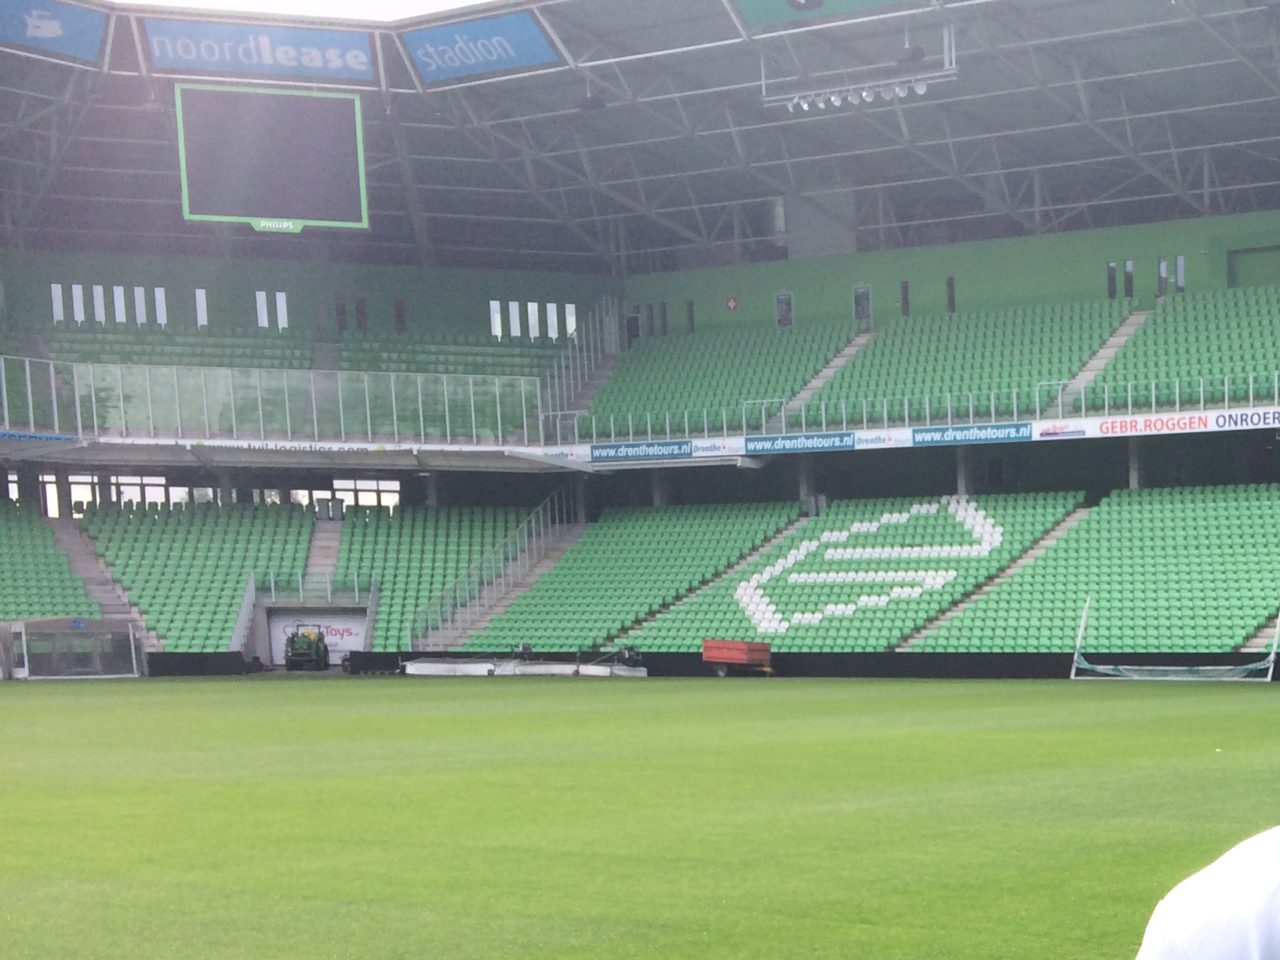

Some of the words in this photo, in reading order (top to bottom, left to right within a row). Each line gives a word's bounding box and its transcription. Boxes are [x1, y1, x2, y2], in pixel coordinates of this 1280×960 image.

[152, 36, 369, 71] noordlease
[417, 34, 516, 71] stadion
[260, 220, 294, 230] PHILIPS
[913, 424, 1031, 442] www.drenthetours.nl
[1099, 415, 1209, 435] GEBR.ROGGEN
[593, 442, 691, 458] www.drenthetours.nl
[747, 434, 854, 450] www.drenthetours.nl
